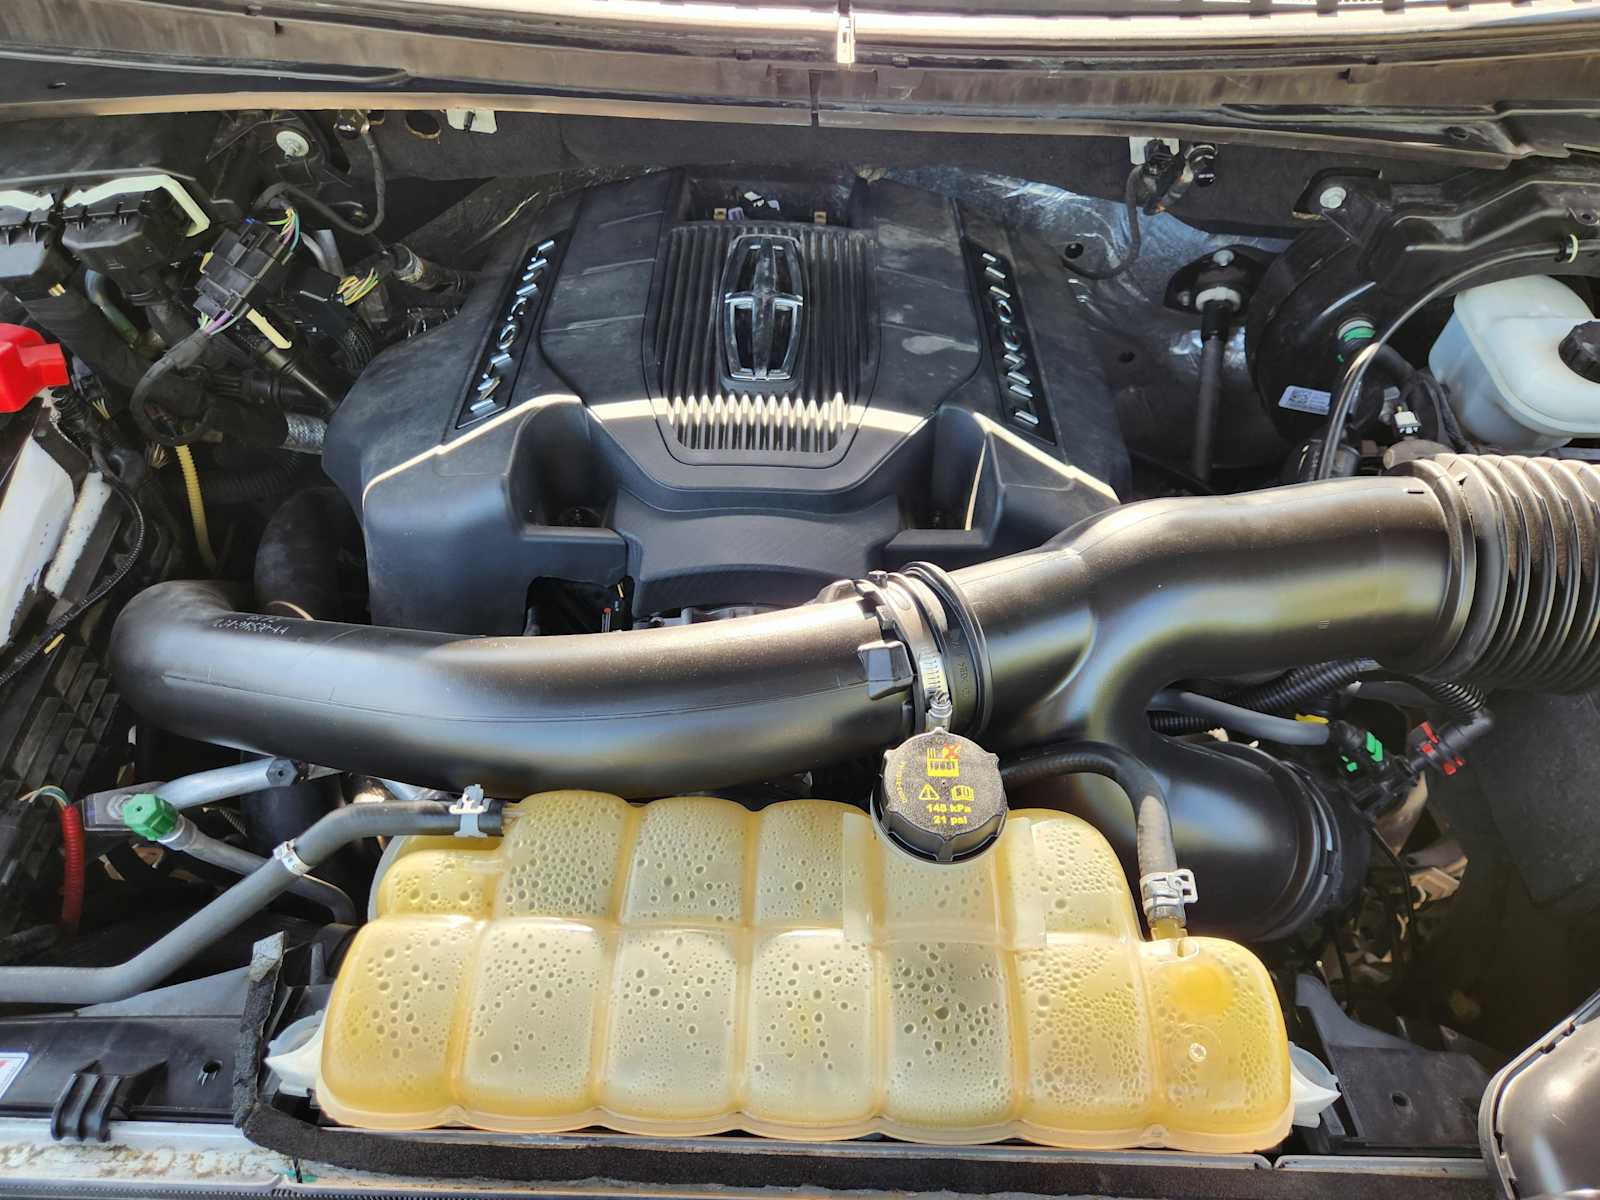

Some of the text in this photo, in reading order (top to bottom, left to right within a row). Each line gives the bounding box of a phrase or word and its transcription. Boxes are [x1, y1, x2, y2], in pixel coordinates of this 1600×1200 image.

[469, 239, 556, 417] LINCOLN
[981, 252, 1041, 426] LINCOLN
[932, 815, 968, 826] 21 psi
[949, 803, 973, 814] kPa
